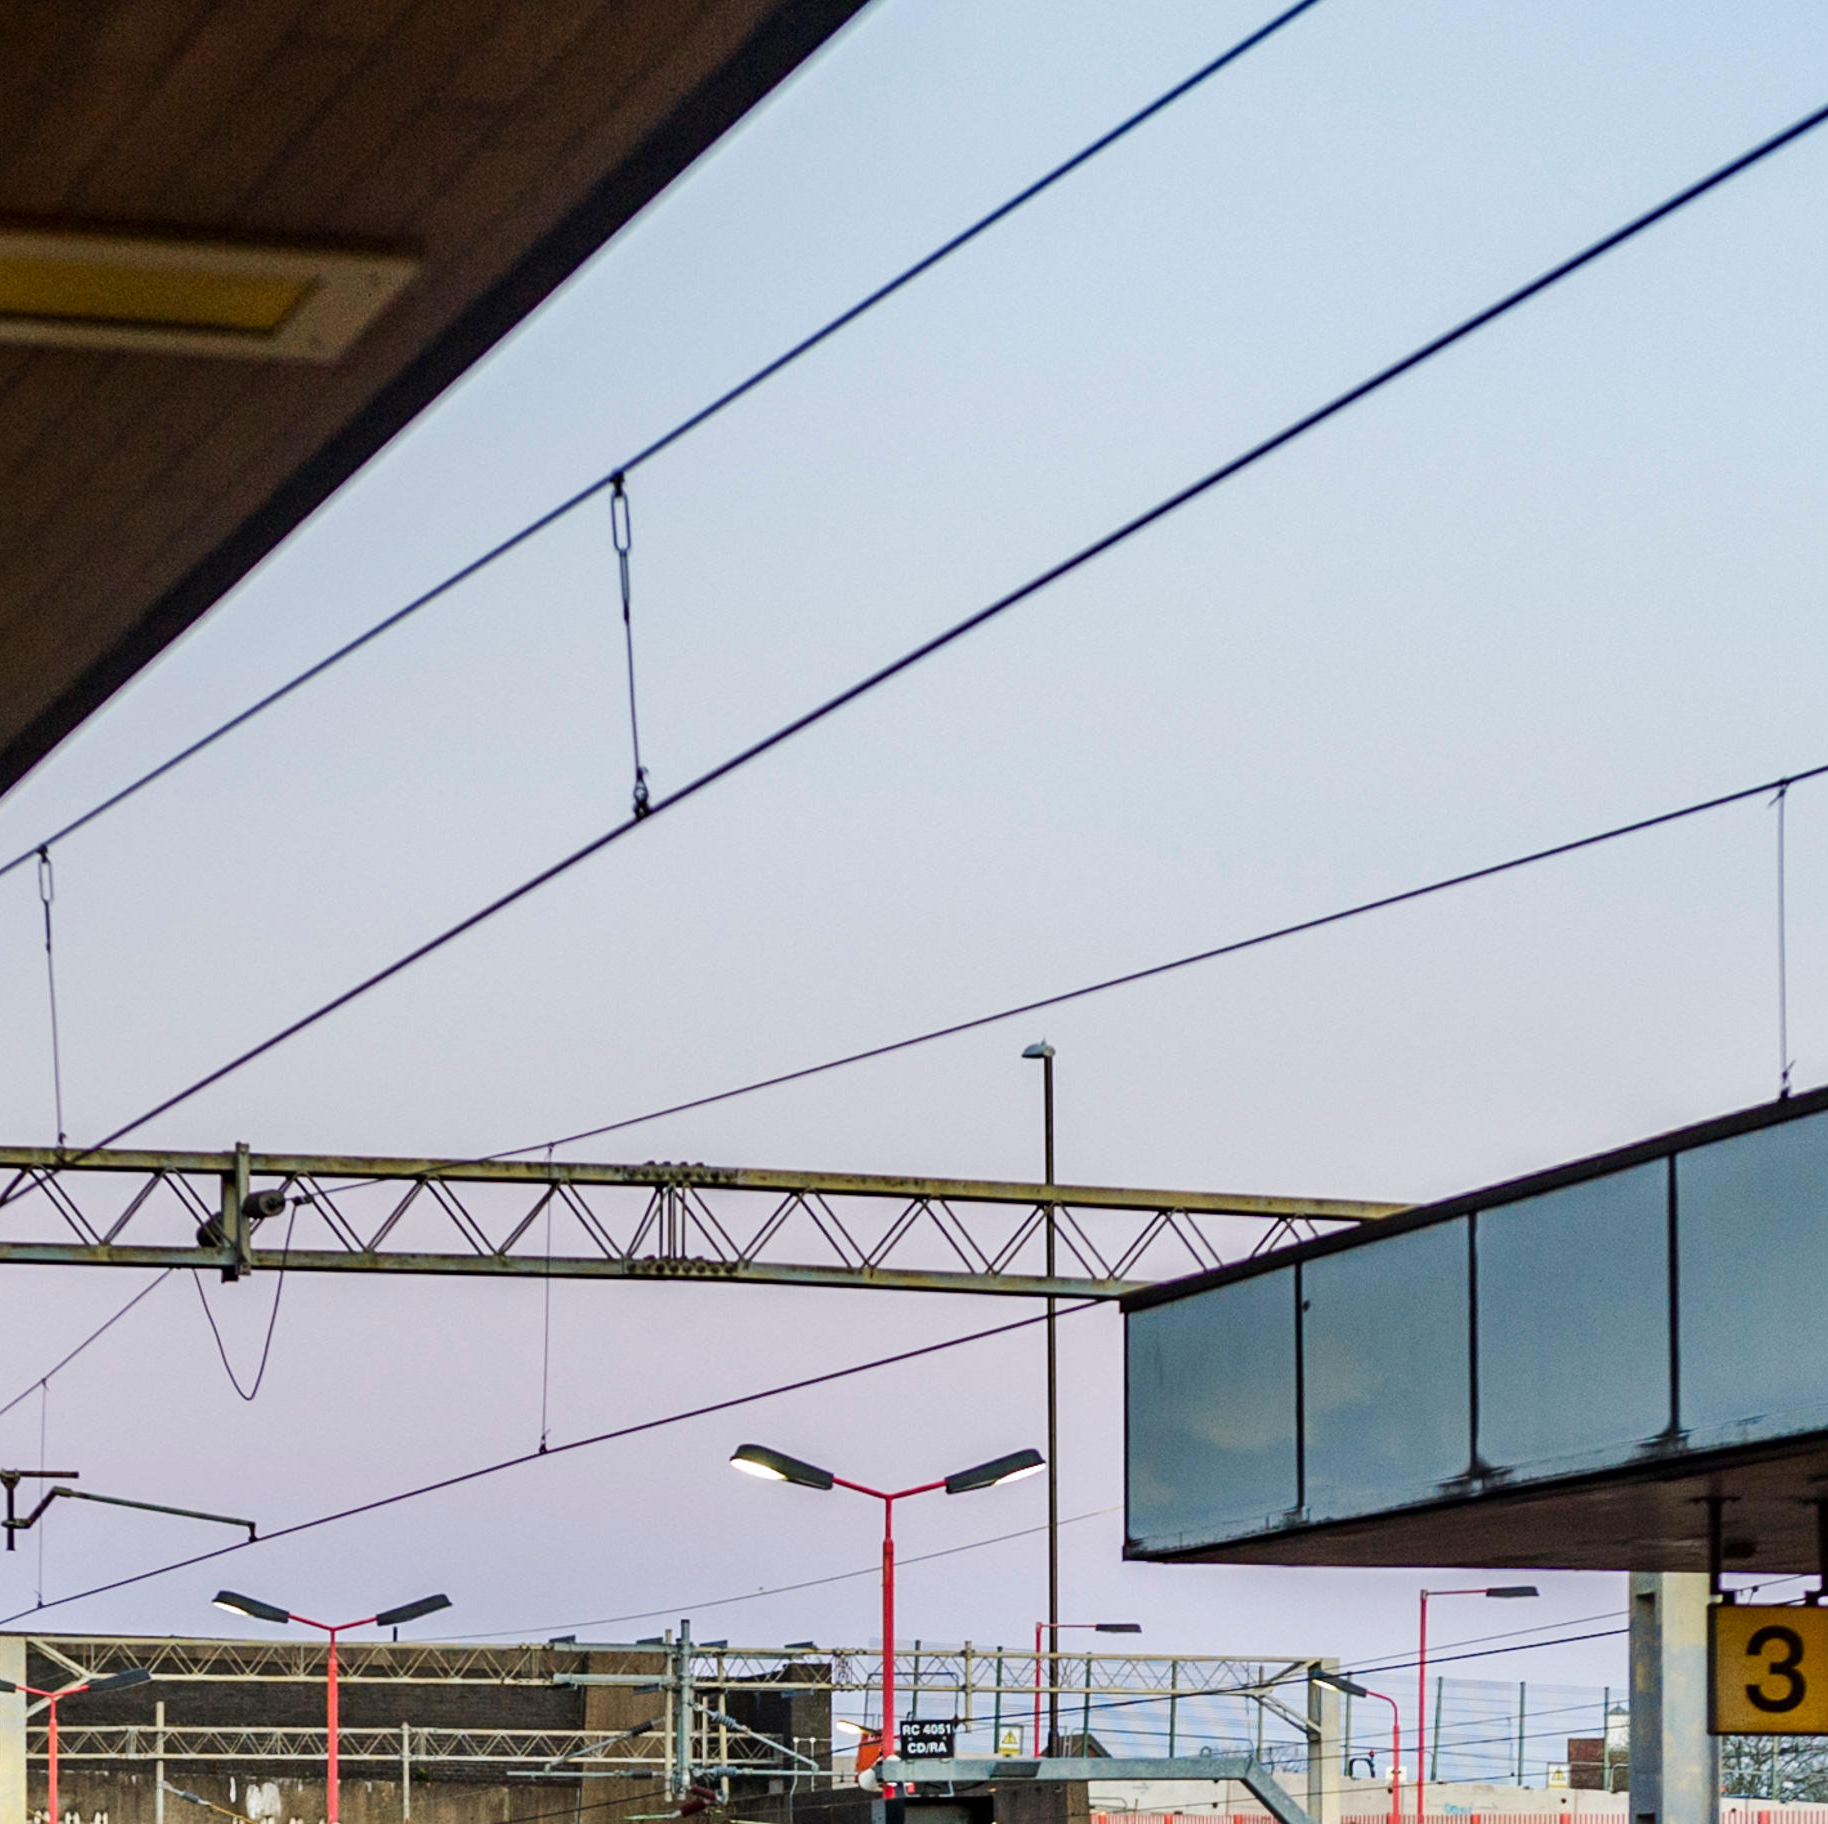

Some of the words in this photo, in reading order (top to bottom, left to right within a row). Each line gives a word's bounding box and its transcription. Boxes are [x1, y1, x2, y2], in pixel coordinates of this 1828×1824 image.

[1744, 1624, 1808, 1714] 3
[902, 1724, 921, 1736] RC
[923, 1723, 951, 1735] 4051
[907, 1741, 948, 1754] CD/RA
